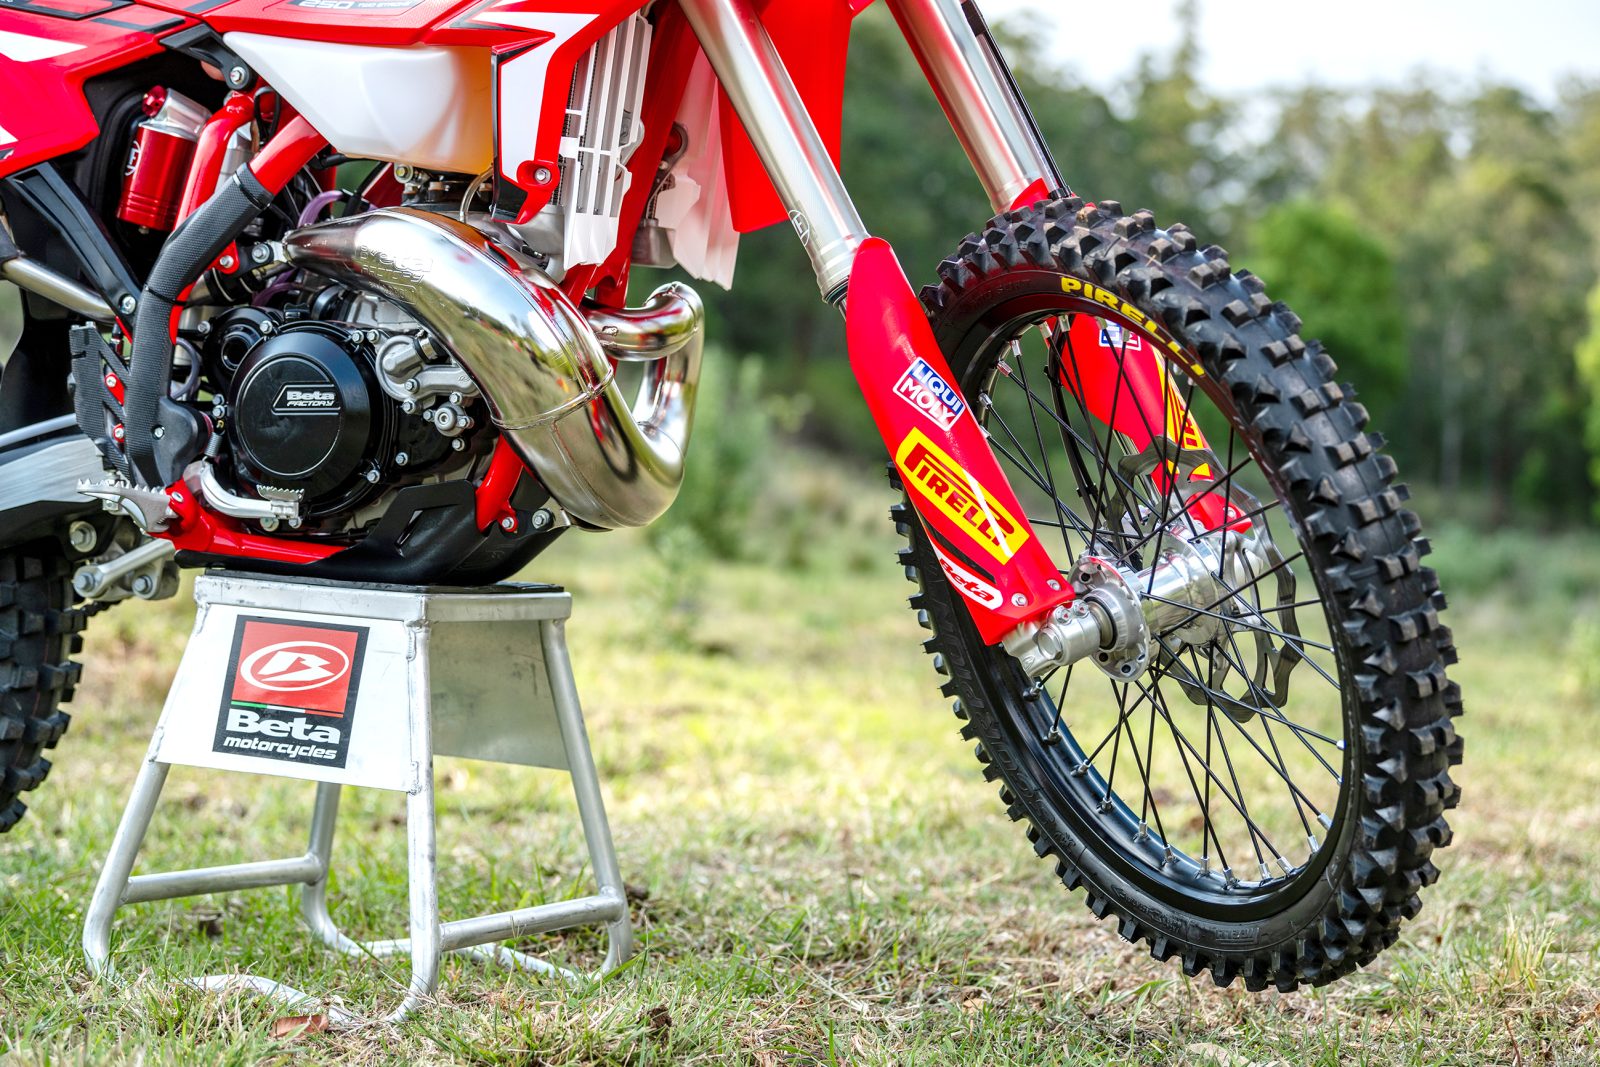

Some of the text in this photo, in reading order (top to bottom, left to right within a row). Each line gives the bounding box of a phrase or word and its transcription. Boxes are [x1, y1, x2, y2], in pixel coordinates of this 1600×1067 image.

[1061, 276, 1205, 376] PIRELLI
[286, 391, 336, 400] Beta
[899, 376, 956, 422] MOLY
[911, 362, 962, 412] LIQUI
[939, 558, 995, 602] Beta
[223, 736, 338, 760] motorcycles
[225, 708, 341, 744] Beta
